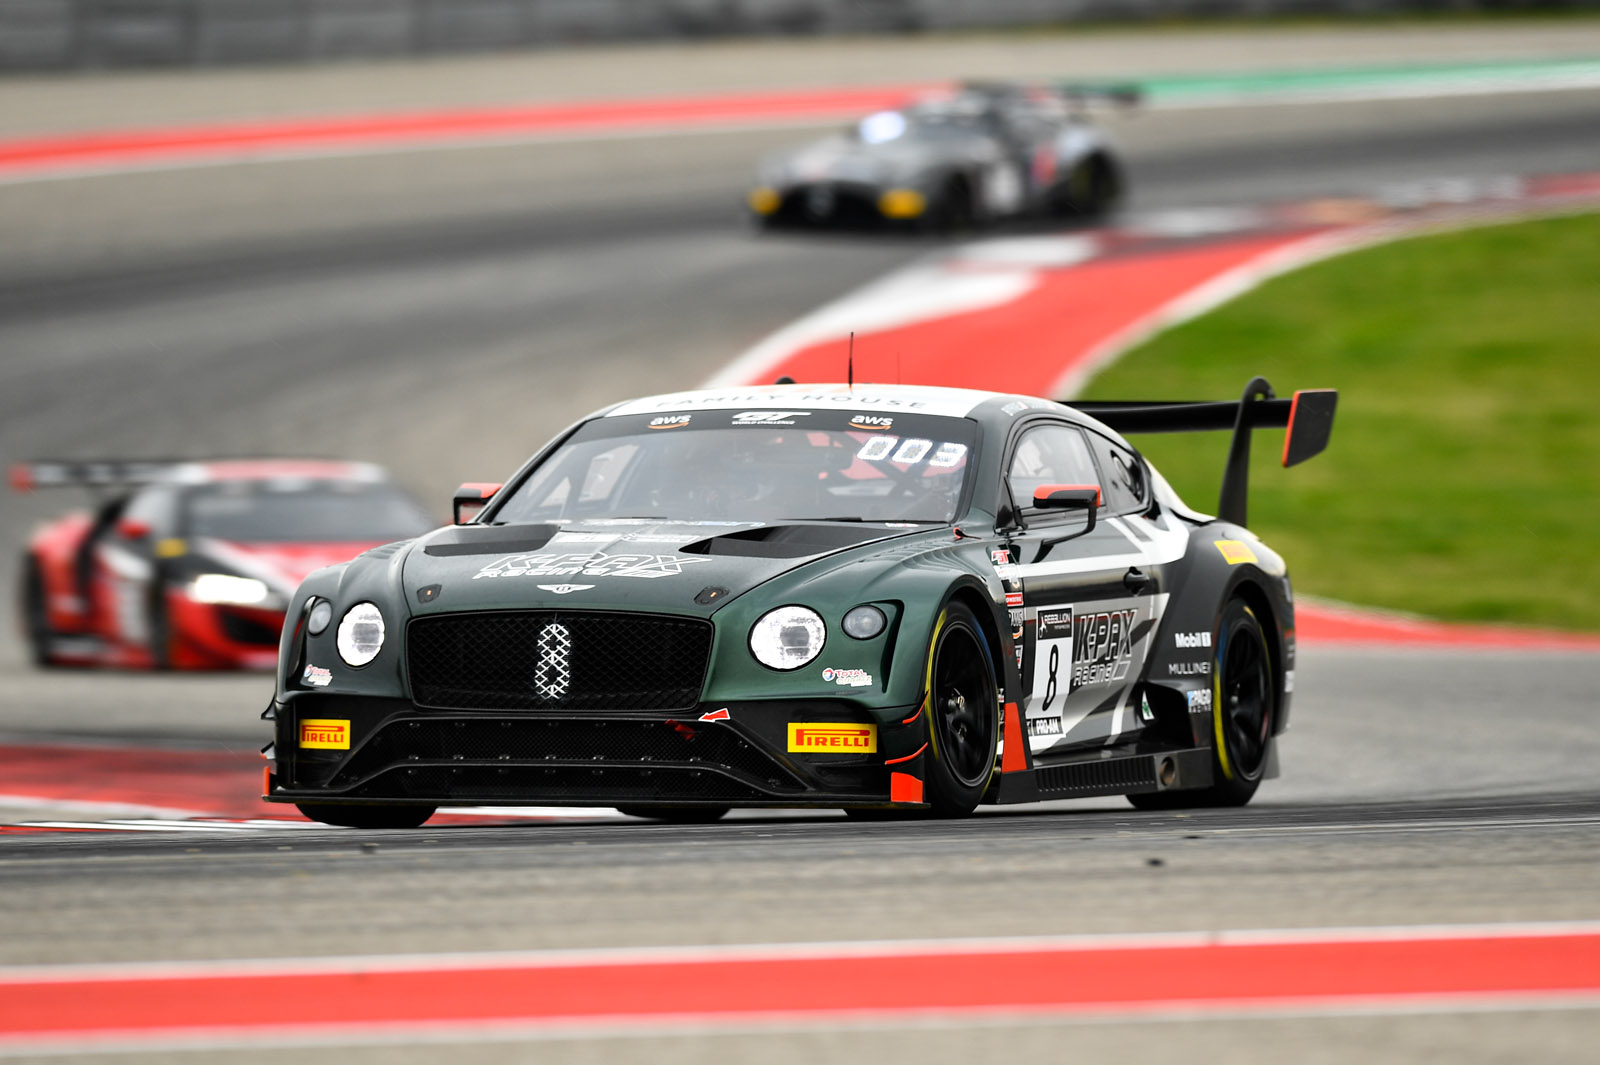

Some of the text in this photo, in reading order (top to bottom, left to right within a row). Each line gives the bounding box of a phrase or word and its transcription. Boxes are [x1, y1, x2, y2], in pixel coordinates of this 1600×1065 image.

[802, 395, 927, 409] HOUSE
[650, 414, 692, 426] aws
[851, 415, 894, 426] aws
[857, 436, 968, 468] 003
[1044, 613, 1071, 625] REBELLION
[1075, 609, 1137, 664] K-PAX
[1174, 632, 1202, 649] Mobil
[835, 670, 866, 678] TOTAL
[1042, 644, 1059, 711] 8
[302, 725, 345, 743] PIRELLI
[1036, 718, 1060, 735] PRO-AM
[795, 728, 870, 747] PIRELLI
